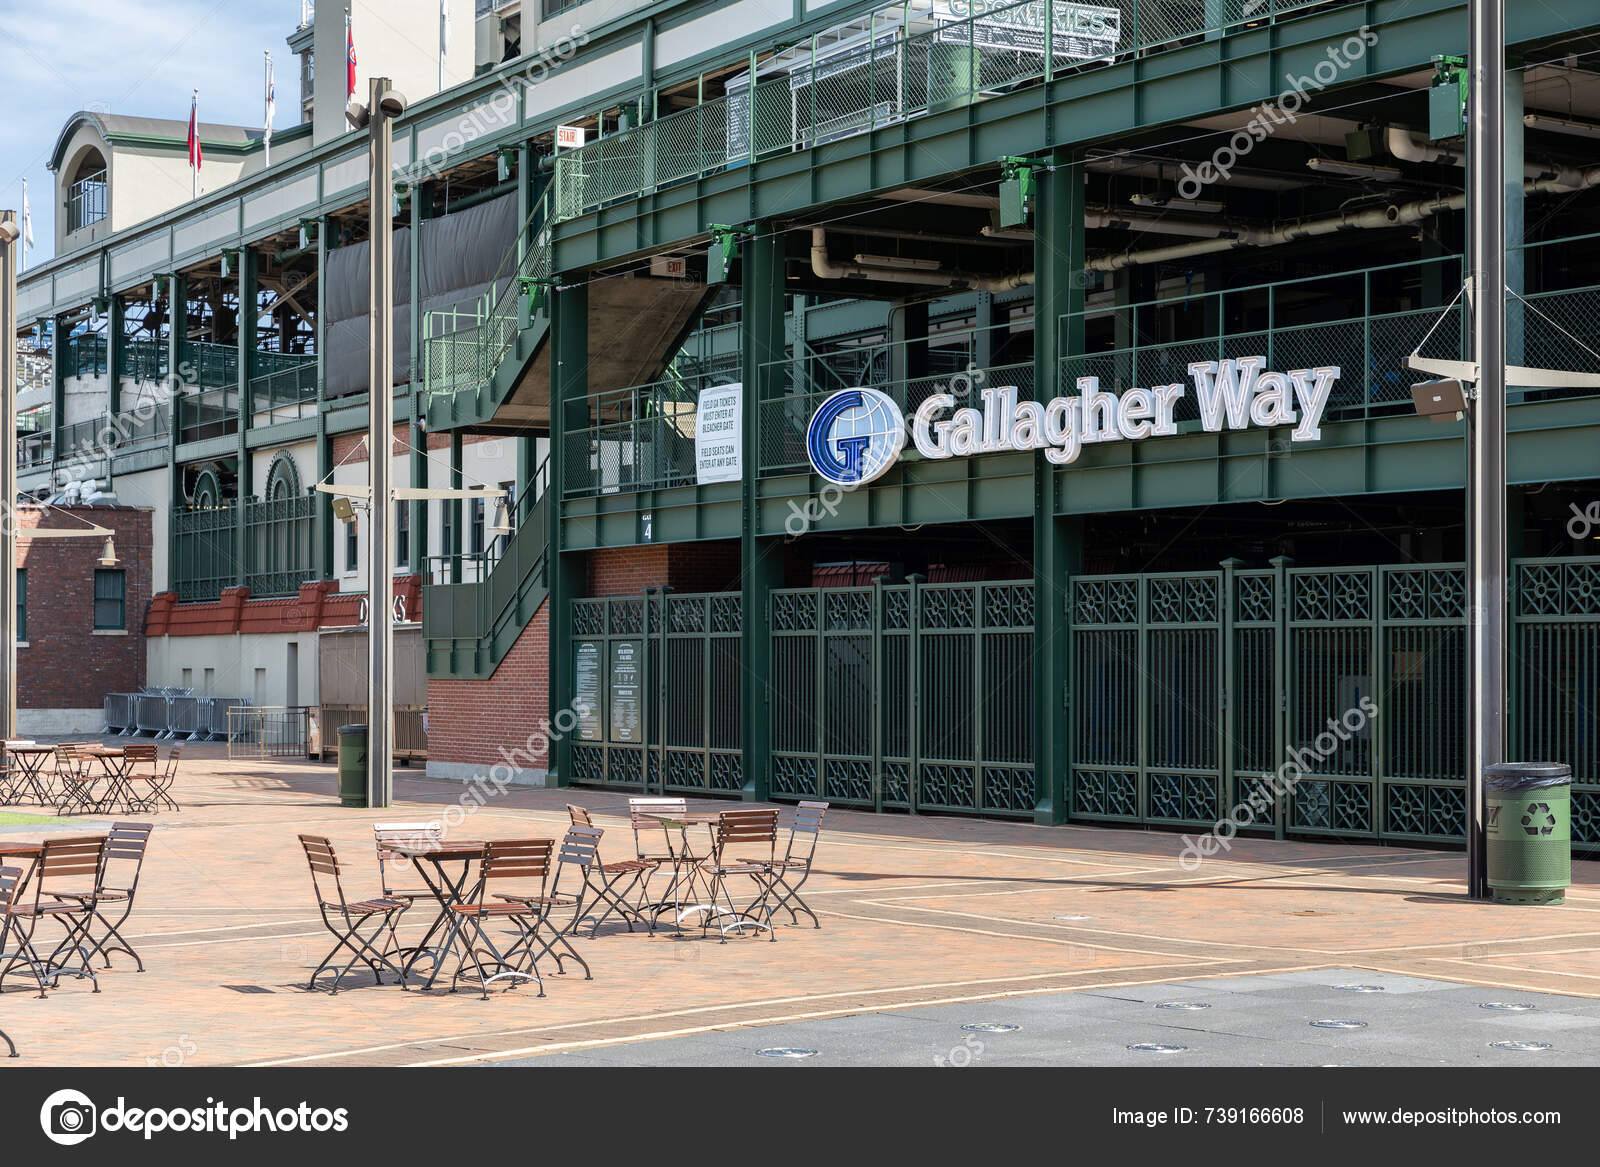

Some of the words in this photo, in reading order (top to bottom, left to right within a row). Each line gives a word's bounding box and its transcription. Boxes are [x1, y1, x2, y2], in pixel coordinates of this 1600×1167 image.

[559, 130, 576, 142] STAIR
[667, 261, 682, 273] EXIT
[703, 400, 712, 409] FIELD
[720, 397, 736, 406] TICKETS
[703, 411, 714, 421] MUST
[714, 410, 727, 419] ENTER
[913, 375, 1184, 465] Gallagher
[1187, 355, 1341, 442] Way
[702, 422, 722, 433] BLEACHER
[723, 420, 734, 430] GATE
[701, 447, 712, 457] FIELD
[712, 446, 725, 456] SEATS
[725, 445, 735, 454] CAN
[700, 459, 711, 469] ENTER
[717, 458, 725, 467] ANY
[726, 456, 736, 466] GATE
[644, 523, 652, 539] 4
